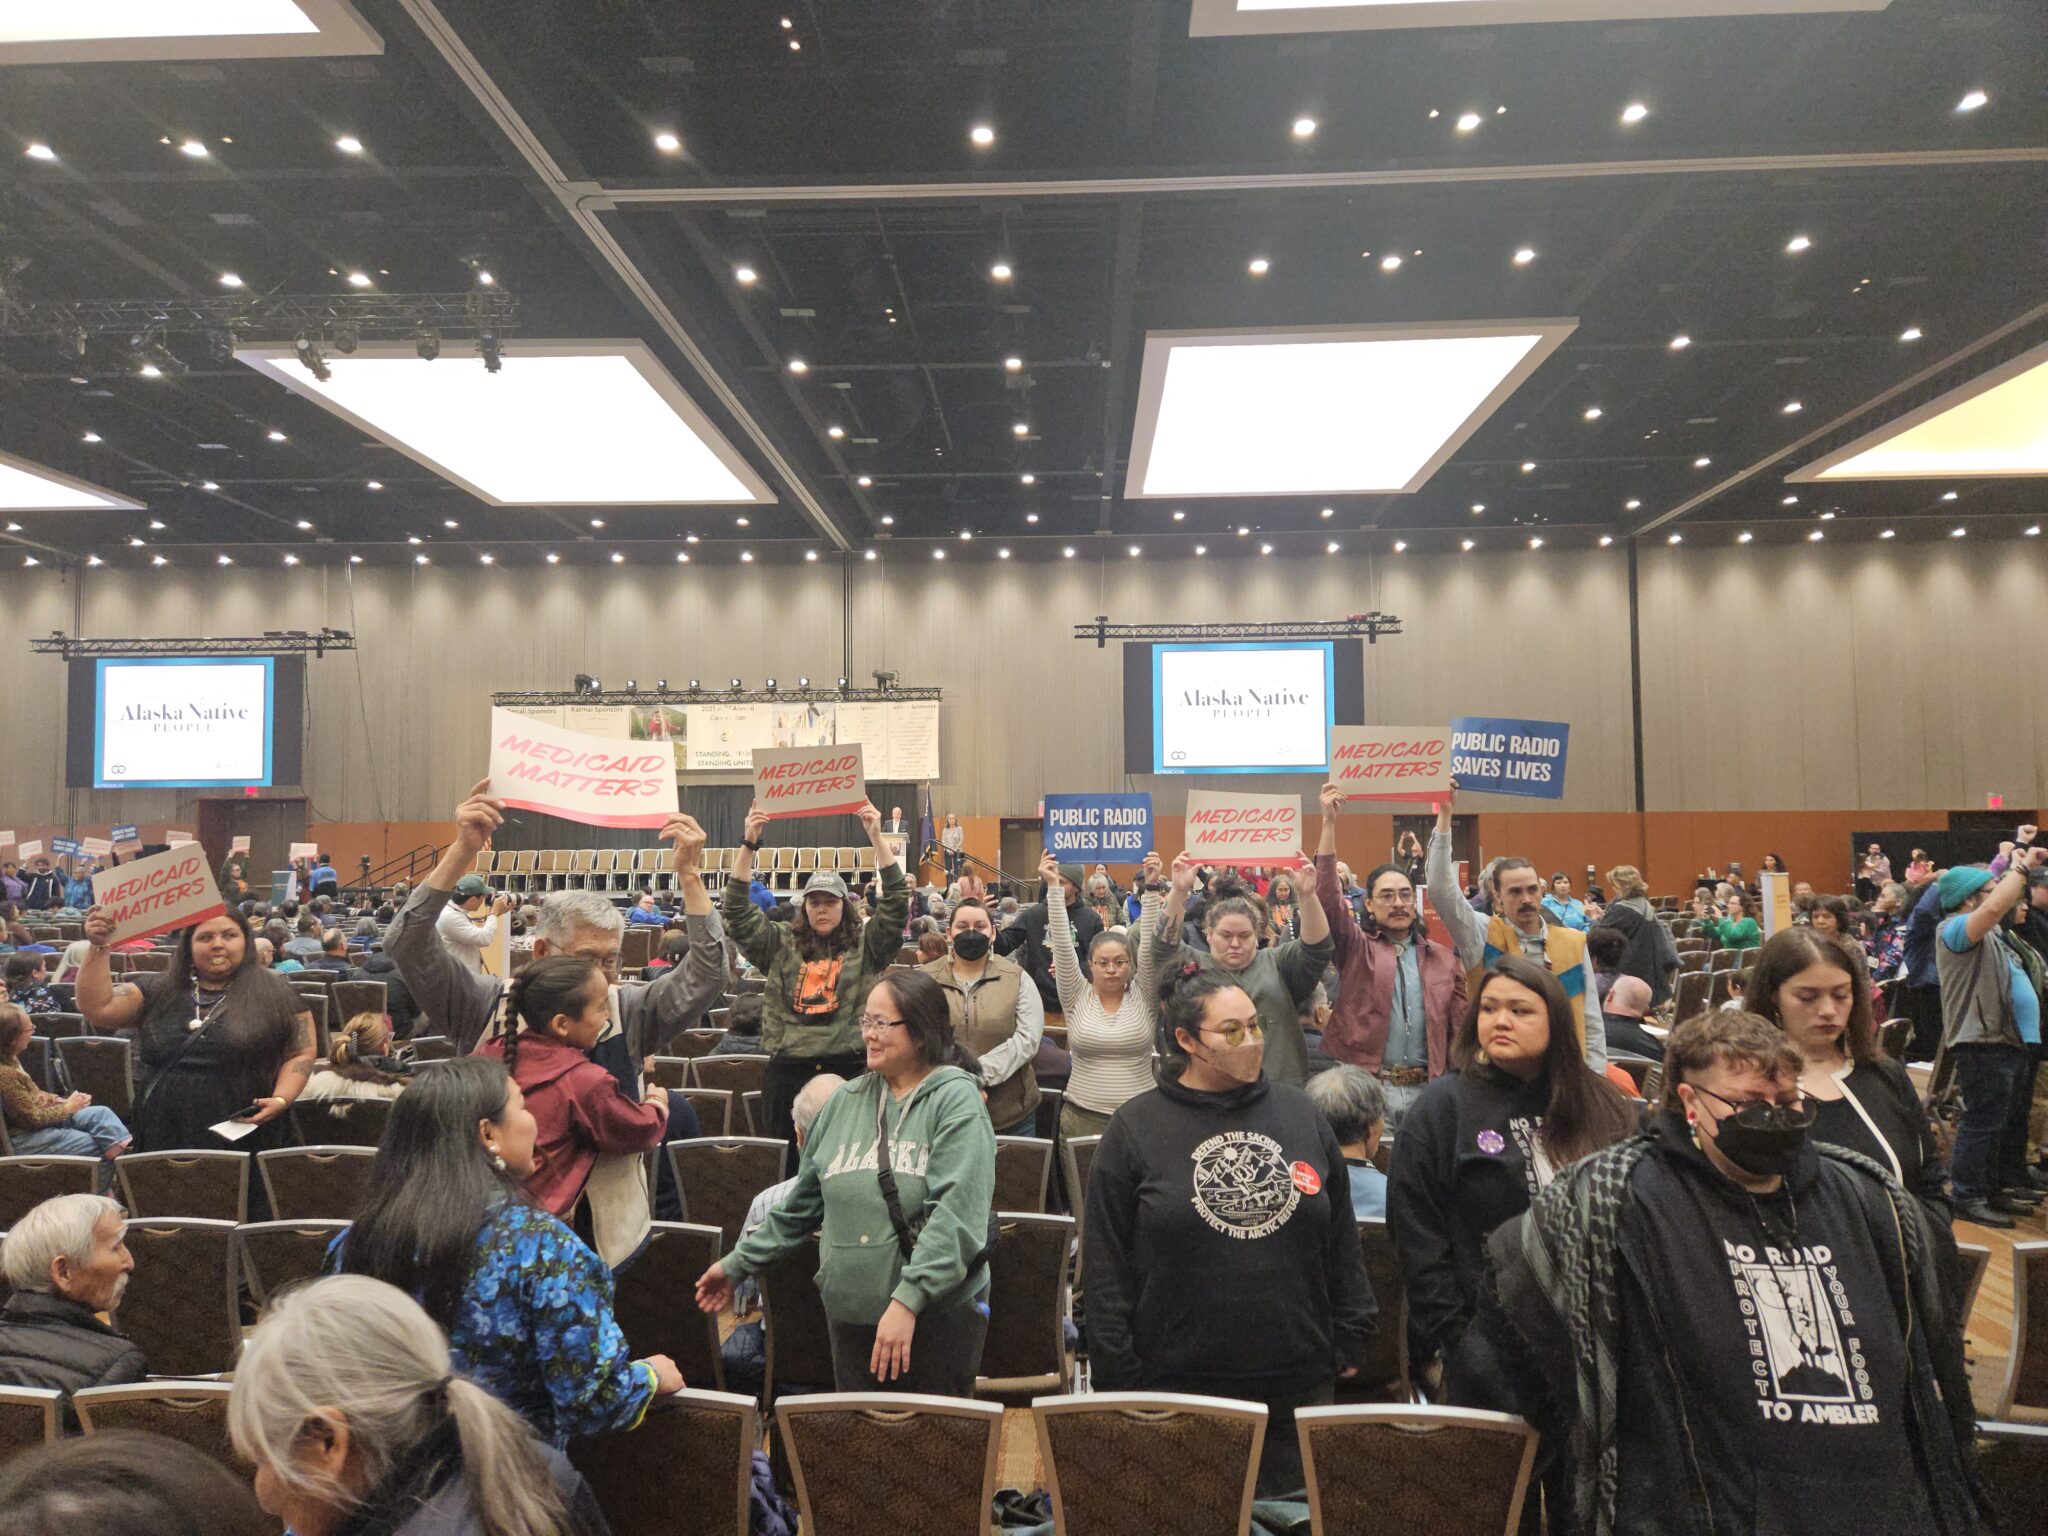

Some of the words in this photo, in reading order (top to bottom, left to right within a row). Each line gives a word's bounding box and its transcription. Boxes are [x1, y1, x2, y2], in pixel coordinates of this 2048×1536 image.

[1180, 689, 1243, 706] Alaska
[1249, 688, 1309, 705] Native
[121, 704, 183, 720] Alaska
[189, 703, 248, 720] Native
[1213, 709, 1273, 718] PEOPLE
[154, 723, 214, 732] PEOPLE
[499, 735, 666, 773] MEDICAID
[1334, 739, 1445, 760] MEDICAID
[1451, 732, 1505, 753] PUBLIC
[1510, 736, 1560, 757] RADIO
[507, 761, 664, 797] MATTERS
[758, 755, 858, 781] MEDICAID
[1339, 761, 1442, 780] MATTERS
[1452, 755, 1501, 777] SAVES
[1506, 760, 1552, 782] LIVES
[765, 774, 857, 799] MATTERS
[1050, 808, 1099, 826] PUBLIC
[1104, 807, 1147, 825] RADIO
[1190, 807, 1296, 824] MEDICAID
[1054, 831, 1098, 850] SAVES
[1103, 831, 1142, 849] LIVES
[1196, 827, 1295, 844] MATTERS
[100, 857, 200, 905] MEDICAID
[112, 877, 205, 923] MATTERS
[1509, 1117, 1530, 1131] NO
[1191, 1135, 1224, 1161] DEFEND
[1224, 1131, 1245, 1142] THE
[1247, 1132, 1283, 1154] SACRED
[1191, 1197, 1226, 1233] PROTECT
[1228, 1228, 1246, 1240] THE
[1248, 1221, 1280, 1240] ARCTIC
[1277, 1189, 1302, 1226] REFUGE
[1765, 1245, 1832, 1265] ROAD
[1823, 1265, 1855, 1326] YOUR
[1729, 1260, 1770, 1397] PROTECT
[1849, 1337, 1873, 1400] FOOD
[1758, 1400, 1792, 1421] TO
[1801, 1404, 1880, 1425] AMBLER
